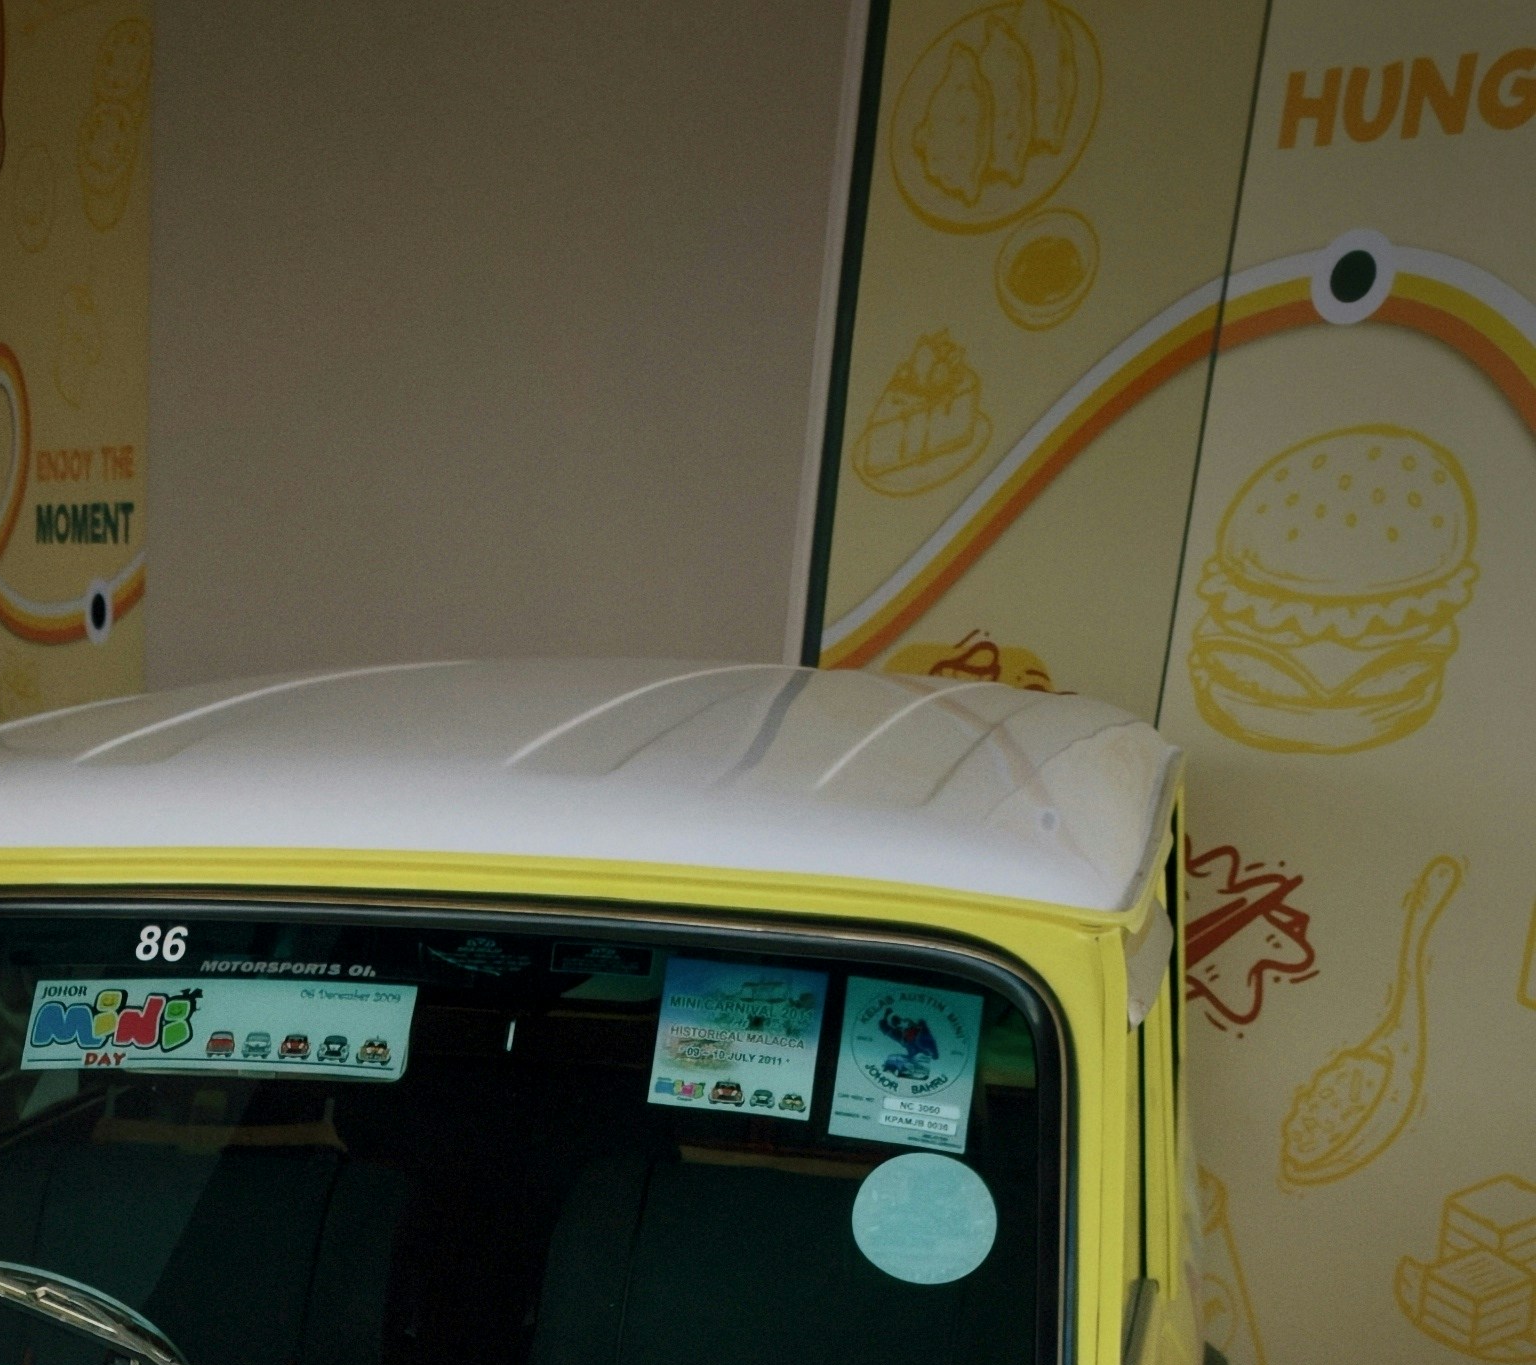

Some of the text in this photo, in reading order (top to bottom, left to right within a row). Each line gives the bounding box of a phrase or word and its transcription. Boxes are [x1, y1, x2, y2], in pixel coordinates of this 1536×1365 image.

[1277, 47, 1536, 150] HUNG
[101, 445, 134, 480] THE
[35, 502, 134, 544] MOMENT
[136, 925, 189, 963] 86
[200, 959, 342, 976] MOTORSPORTS
[42, 985, 88, 1000] JOHOR
[670, 996, 701, 1009] MINI
[705, 999, 774, 1018] CARNIVAL
[670, 1025, 805, 1049] HISTORICAL MALACCA
[84, 1052, 127, 1068] DAY
[687, 1047, 700, 1057] 09
[728, 1052, 756, 1063] JULY
[758, 1054, 783, 1066] 2011
[865, 1064, 949, 1095] JOHOR BAHRU
[900, 1101, 914, 1111] NC
